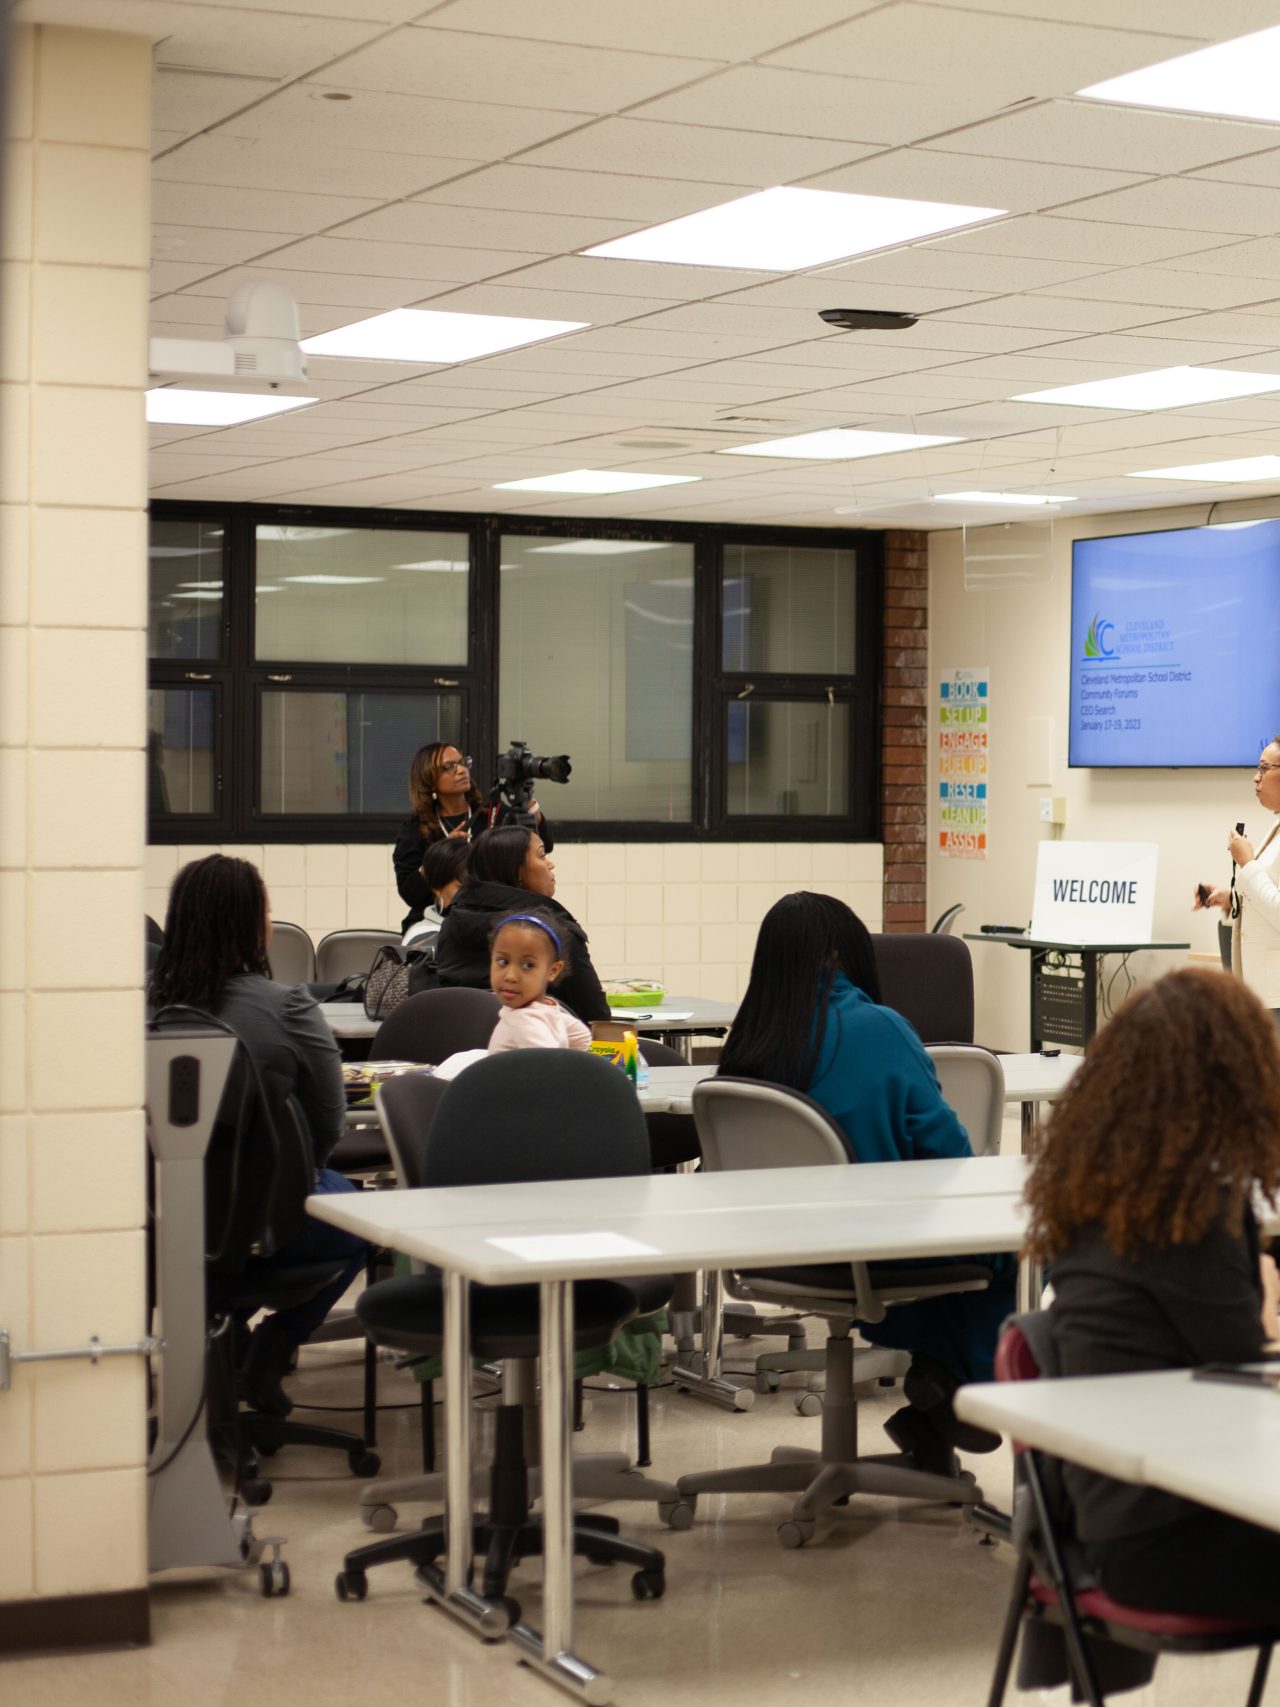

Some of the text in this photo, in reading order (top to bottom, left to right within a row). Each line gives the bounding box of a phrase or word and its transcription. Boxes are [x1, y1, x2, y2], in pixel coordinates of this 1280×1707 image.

[1081, 671, 1192, 685] Cleveland Metropolitan School District
[949, 682, 979, 698] BOOK
[1081, 688, 1138, 700] Community Forums
[946, 706, 982, 723] SET UP
[1081, 705, 1116, 716] CEO Search
[1081, 719, 1103, 731] January
[1125, 718, 1140, 730] 2023
[943, 732, 986, 749] ENGAGE
[948, 783, 978, 799] RESET
[946, 832, 979, 849] ASSIST
[1053, 879, 1138, 904] WELCOME
